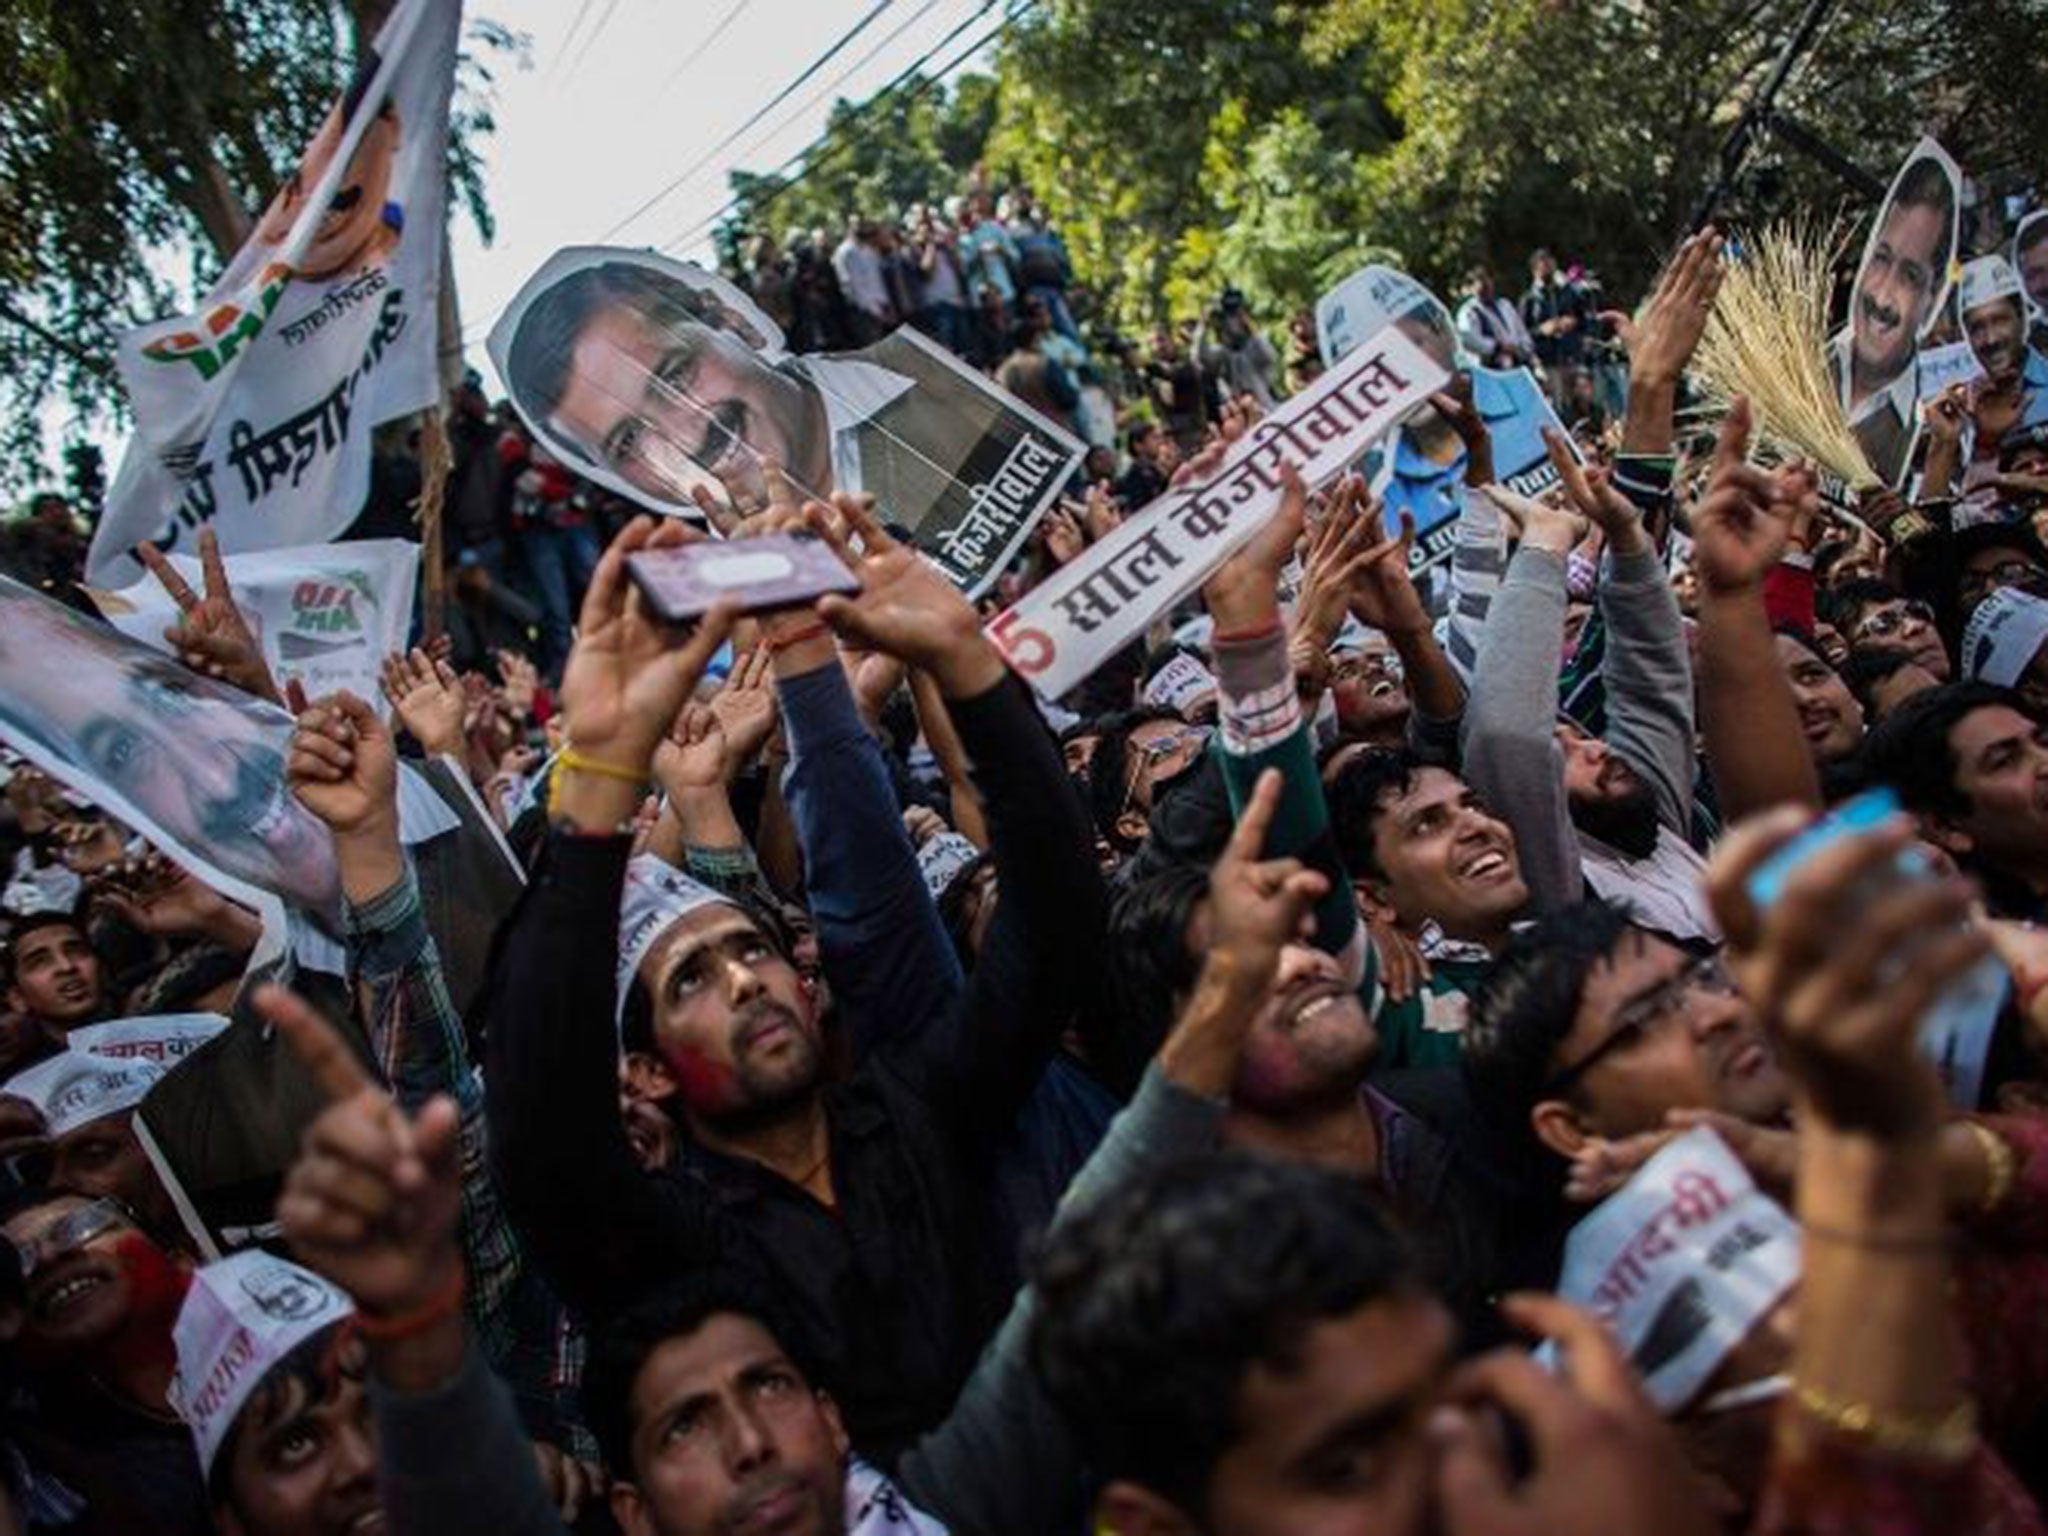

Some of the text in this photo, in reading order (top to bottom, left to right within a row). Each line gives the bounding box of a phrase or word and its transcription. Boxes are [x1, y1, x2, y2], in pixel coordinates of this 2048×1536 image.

[936, 432, 1065, 569] केजरीवाल
[989, 612, 1057, 674] 5
[1052, 528, 1183, 633] साल
[1170, 353, 1412, 540] केजरीवाल
